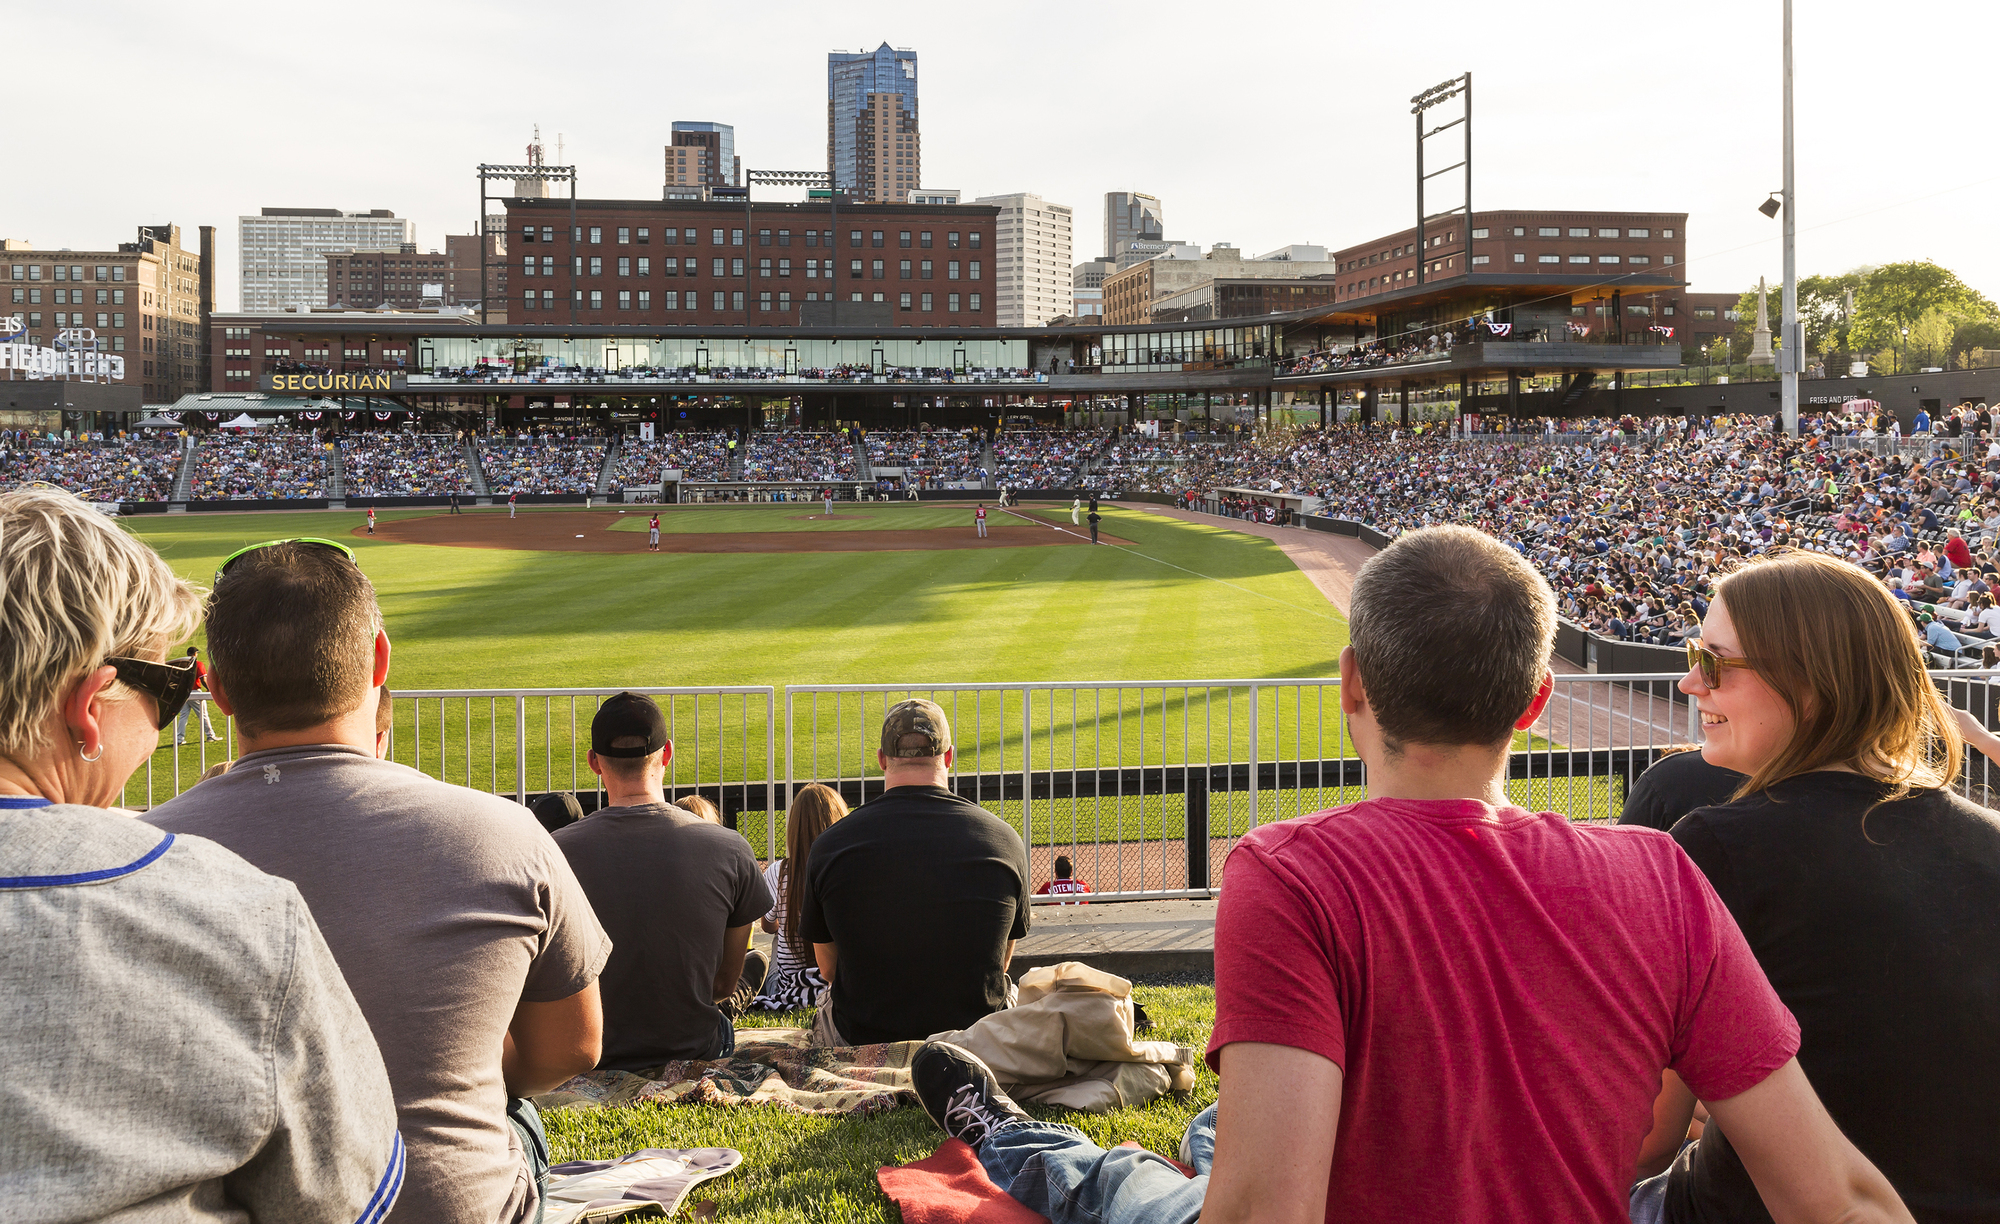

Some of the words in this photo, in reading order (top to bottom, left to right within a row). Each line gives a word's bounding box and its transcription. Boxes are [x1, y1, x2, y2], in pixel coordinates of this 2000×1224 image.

[1138, 242, 1164, 250] Bremer
[0, 343, 57, 374] FIELD
[272, 374, 391, 390] SECURIAN
[1809, 396, 1828, 404] FRIES
